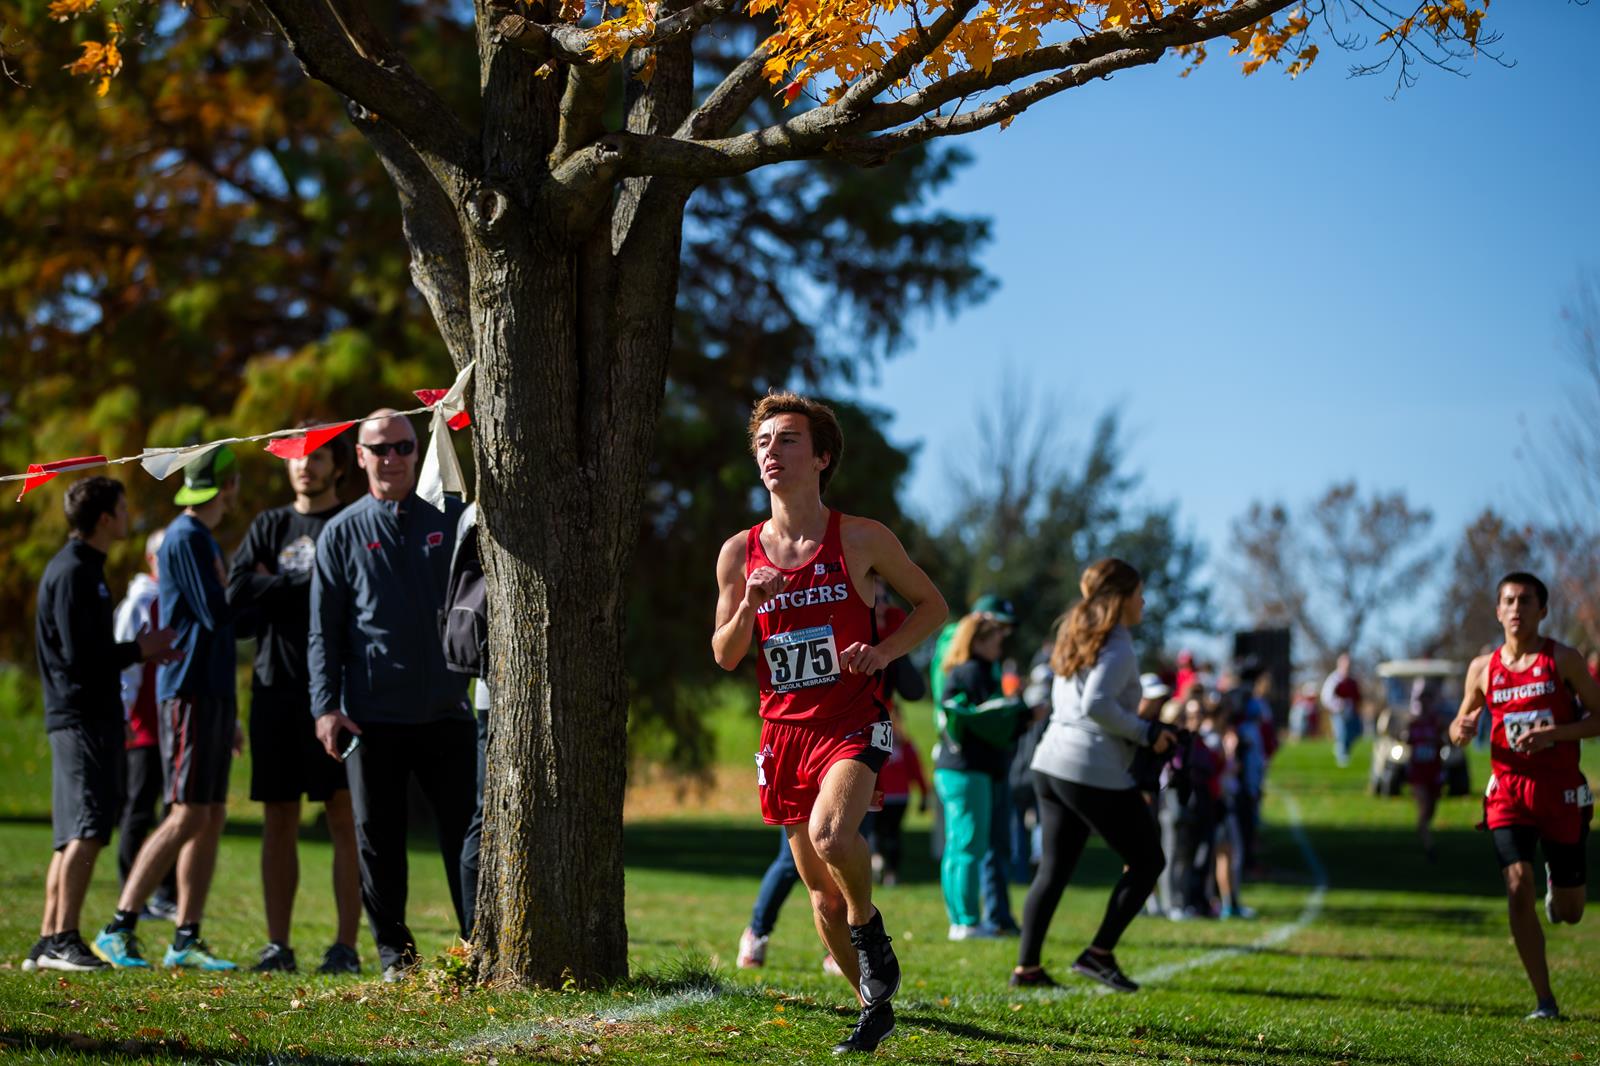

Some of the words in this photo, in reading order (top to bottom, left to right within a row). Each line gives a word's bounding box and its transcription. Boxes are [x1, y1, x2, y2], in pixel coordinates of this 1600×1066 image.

[770, 638, 833, 683] 375
[802, 676, 836, 687] NEBRASKA
[1493, 681, 1555, 703] RUTGERS
